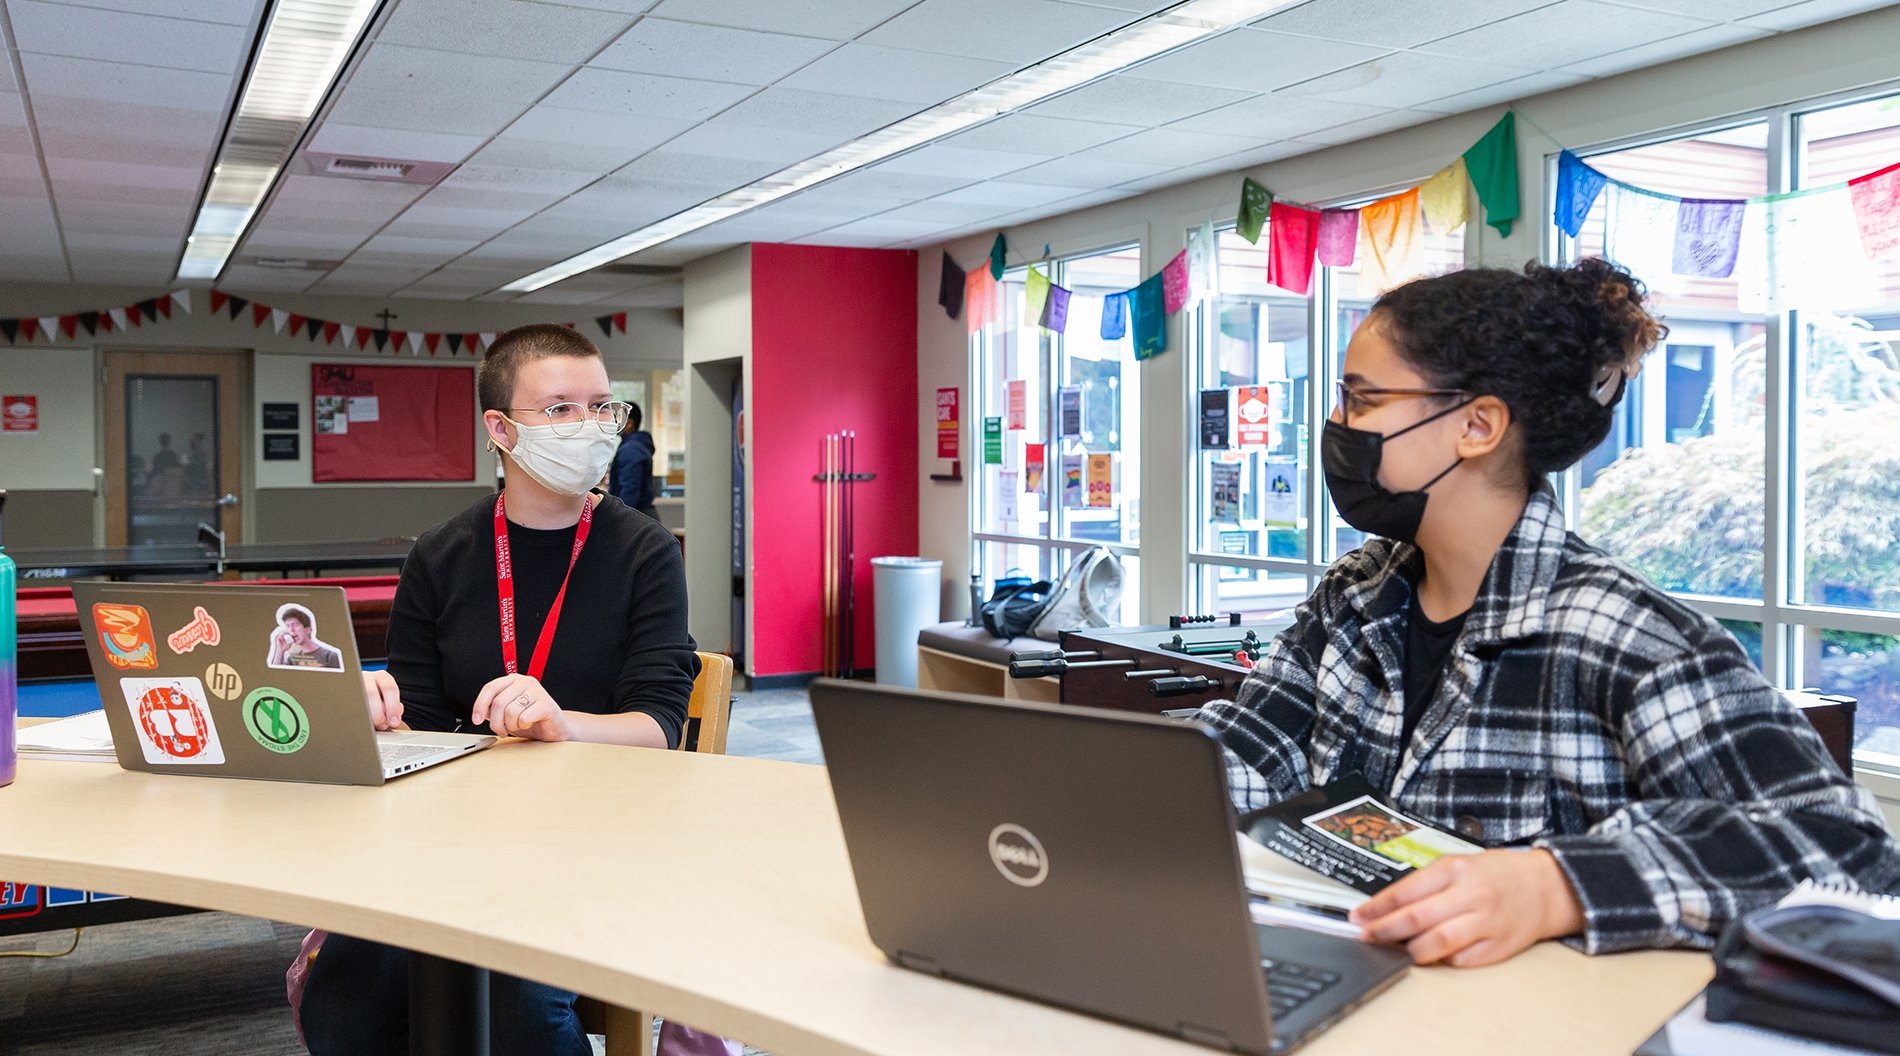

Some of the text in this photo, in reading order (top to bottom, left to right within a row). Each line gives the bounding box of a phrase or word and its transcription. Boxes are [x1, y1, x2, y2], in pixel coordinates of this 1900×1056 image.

[212, 663, 237, 700] hp
[257, 729, 307, 751] END THE STIGMA
